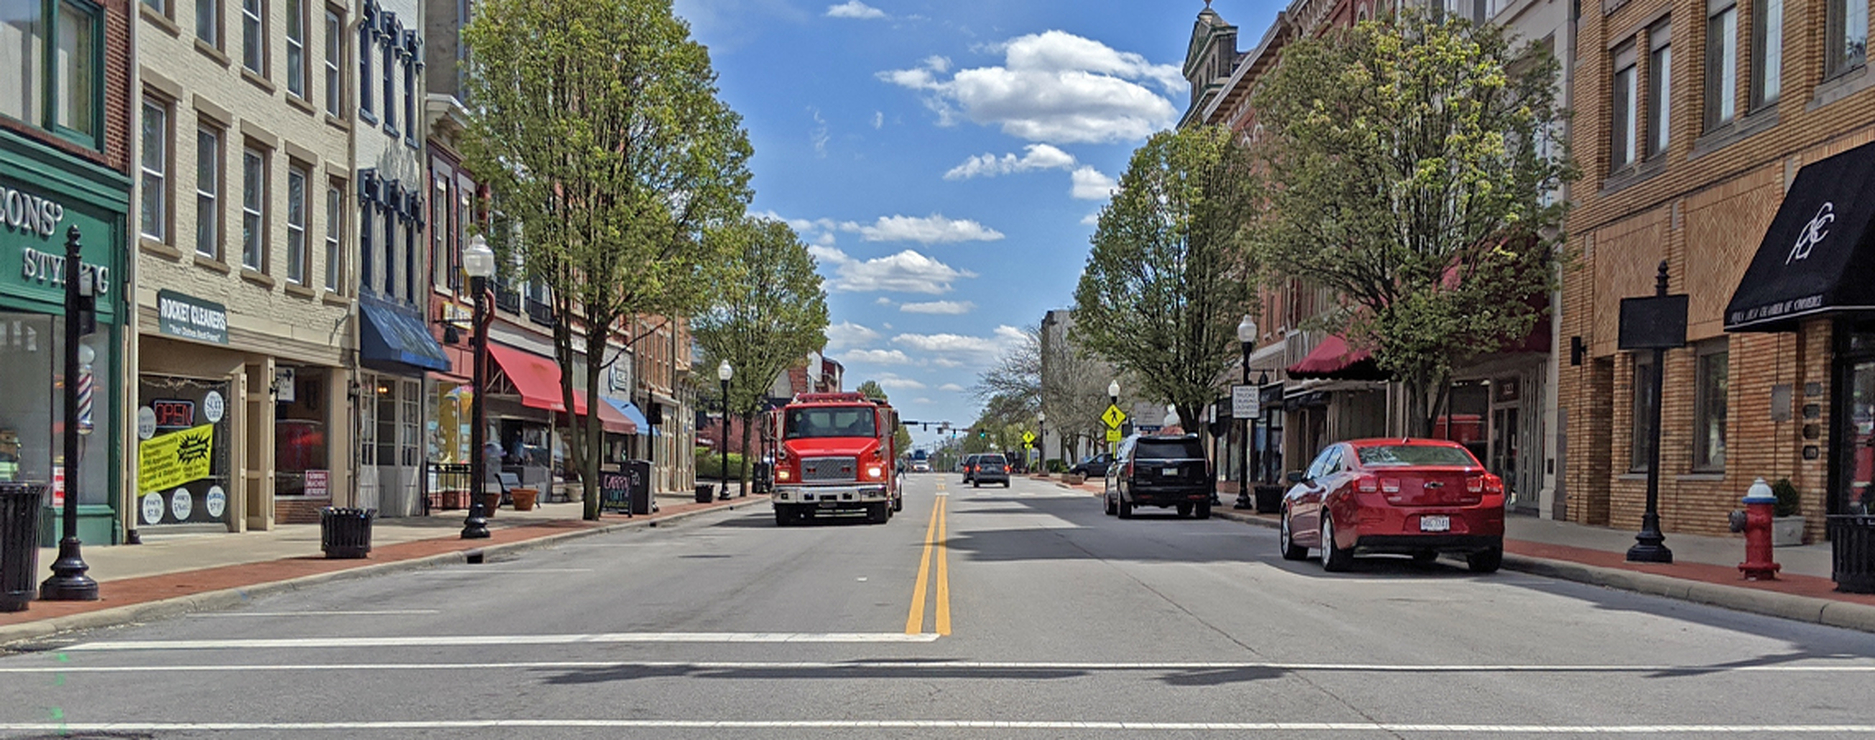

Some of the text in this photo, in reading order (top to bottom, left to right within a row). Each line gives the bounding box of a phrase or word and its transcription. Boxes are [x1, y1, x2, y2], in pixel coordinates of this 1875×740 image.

[161, 297, 227, 332] ROCKET CLEANERS
[1785, 301, 1794, 313] OF
[1794, 295, 1823, 311] COMMERCE
[155, 402, 193, 426] OPEN
